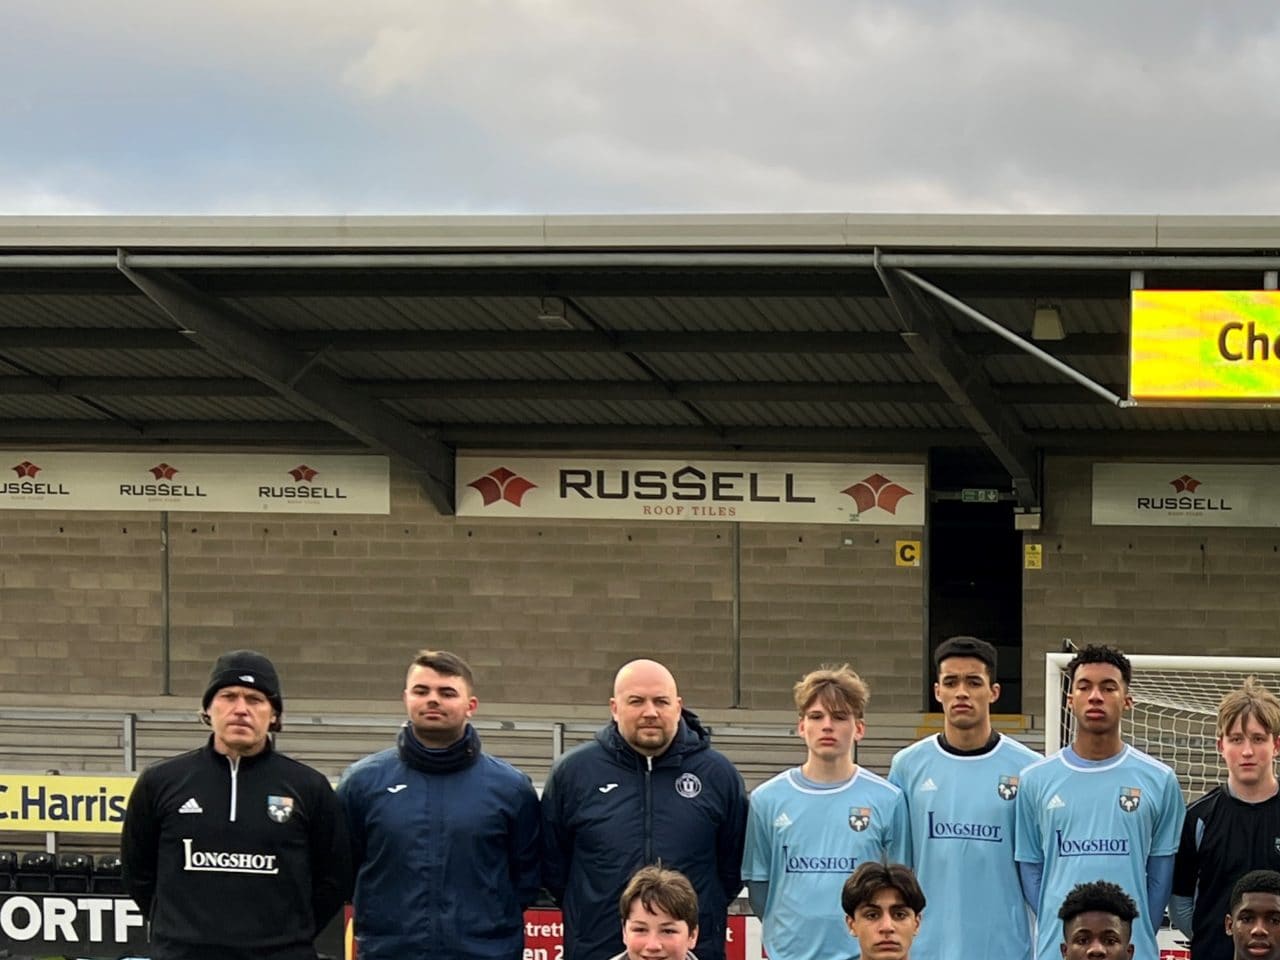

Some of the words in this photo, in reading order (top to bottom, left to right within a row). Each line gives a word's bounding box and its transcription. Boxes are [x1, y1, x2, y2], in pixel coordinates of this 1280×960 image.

[119, 483, 207, 497] RUSSELL
[258, 485, 347, 499] RUSSELL
[559, 465, 816, 503] RUSSELL
[643, 505, 685, 516] ROOF
[692, 506, 737, 517] TILES
[1137, 496, 1232, 511] RUSSELL
[899, 544, 916, 562] C
[928, 811, 1003, 842] LONGSHOT
[1055, 829, 1130, 857] LONGSHOT
[182, 838, 279, 874] LONGSHOT
[782, 845, 858, 874] LONGSHOT
